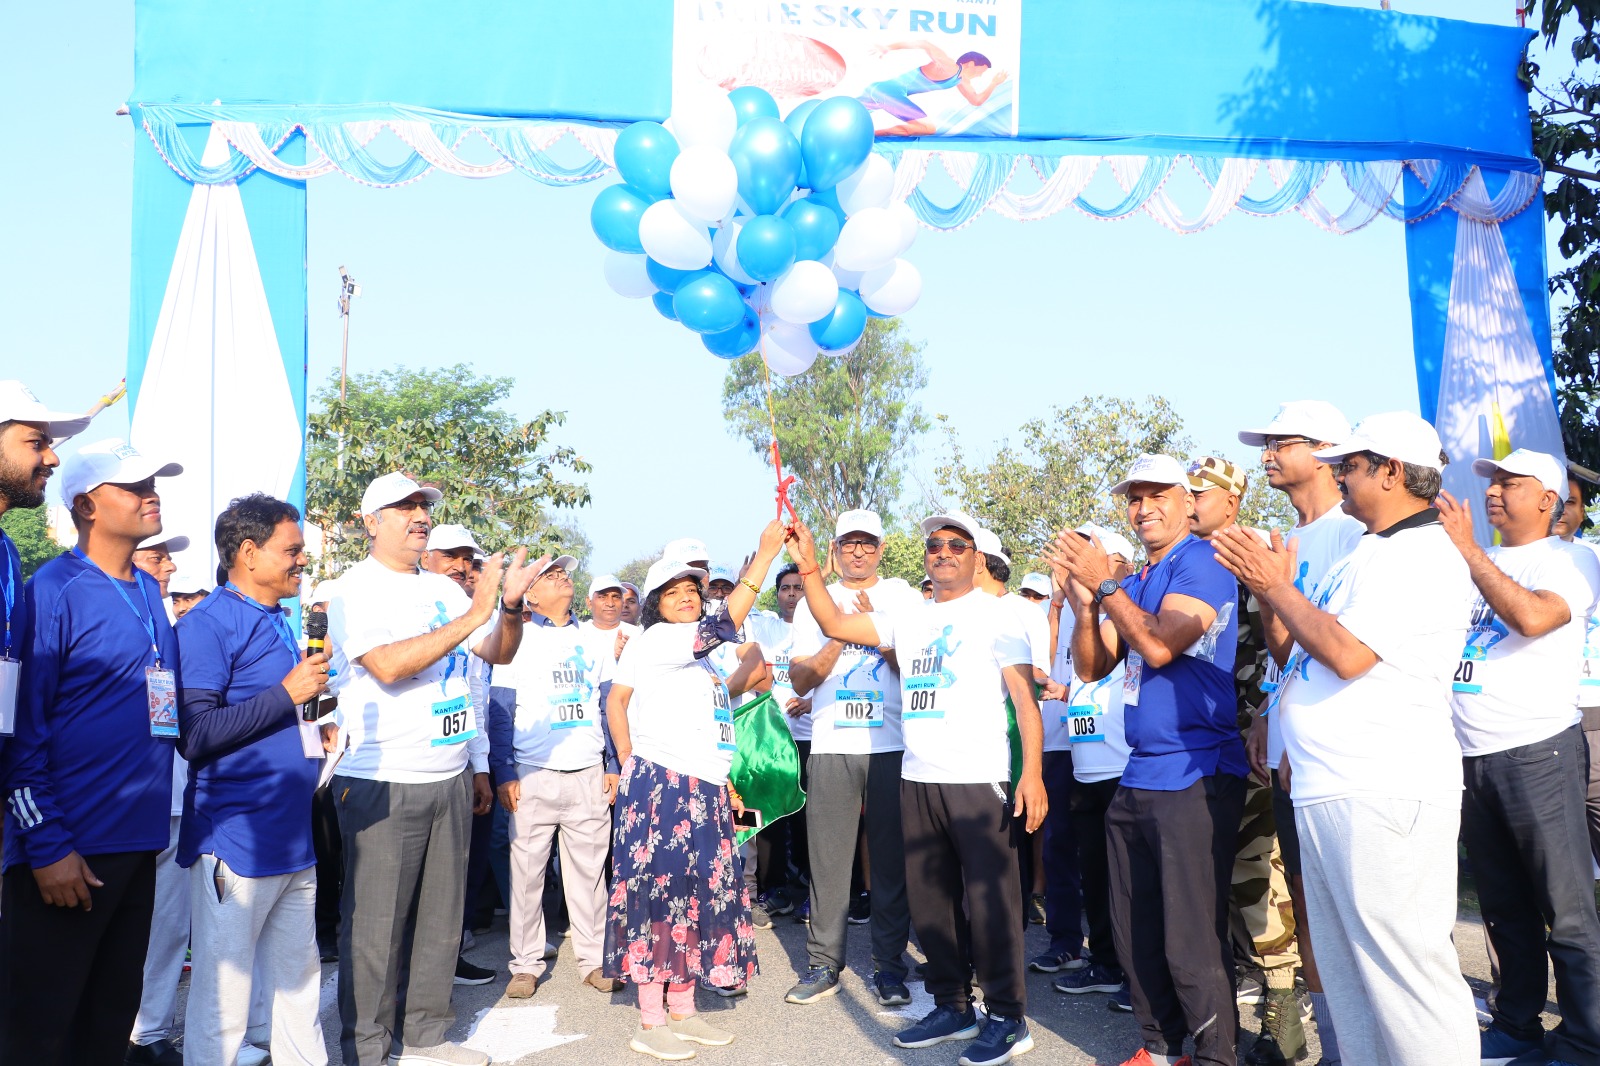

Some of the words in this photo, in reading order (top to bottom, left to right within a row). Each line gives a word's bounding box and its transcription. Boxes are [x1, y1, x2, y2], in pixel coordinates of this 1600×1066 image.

[812, 4, 899, 30] SKY
[910, 9, 997, 37] RUN
[1470, 607, 1495, 626] UN
[921, 647, 934, 656] THE
[558, 661, 572, 669] THE
[911, 655, 943, 676] RUN
[1453, 660, 1473, 683] 20
[552, 669, 585, 684] RUN
[777, 670, 790, 683] 09
[910, 689, 936, 711] 001
[434, 705, 454, 715] KANTI
[558, 703, 584, 722] 076
[845, 702, 874, 720] 002
[442, 709, 467, 737] 057
[1073, 716, 1096, 736] 003
[719, 722, 733, 744] 201
